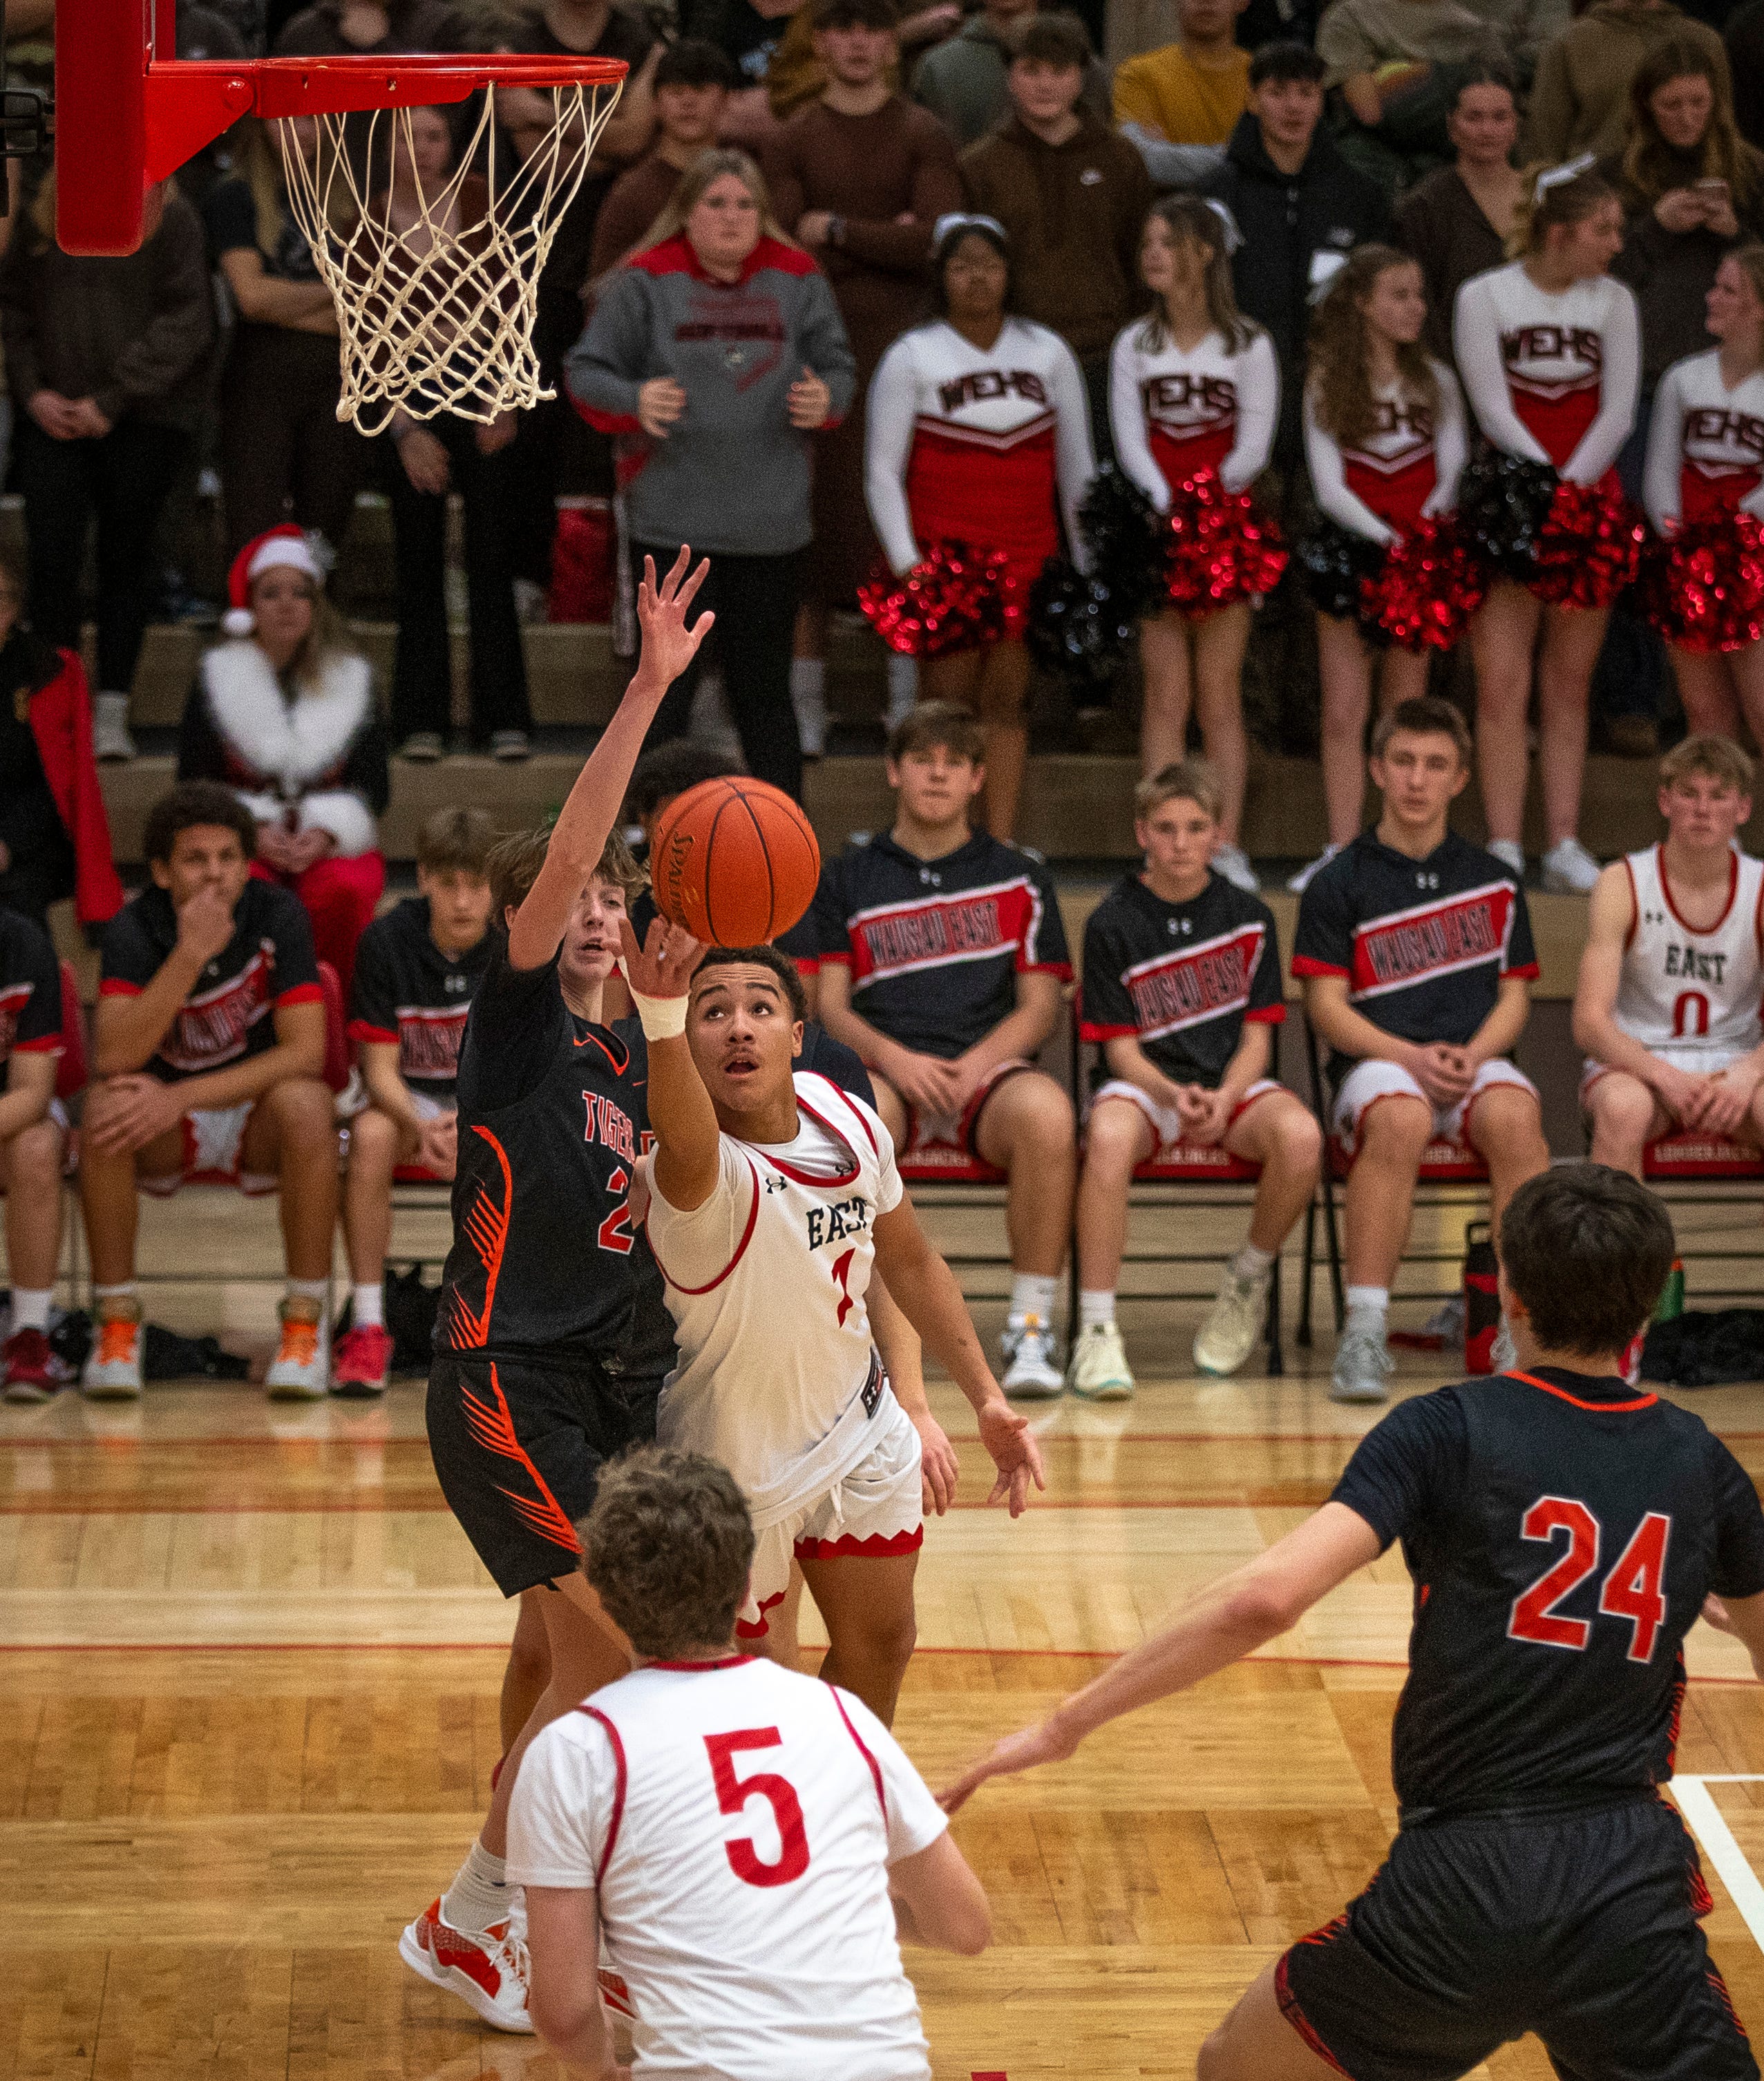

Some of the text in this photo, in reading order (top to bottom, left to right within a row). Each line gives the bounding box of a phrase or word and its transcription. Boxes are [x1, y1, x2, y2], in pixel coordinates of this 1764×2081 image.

[947, 899, 1005, 952] EAST
[1444, 900, 1499, 959] EAST
[1665, 943, 1726, 985] EAST
[806, 1196, 868, 1251] EAST
[831, 1247, 853, 1329] 1
[1507, 1496, 1671, 1664] 24
[702, 1726, 810, 1889] 5
